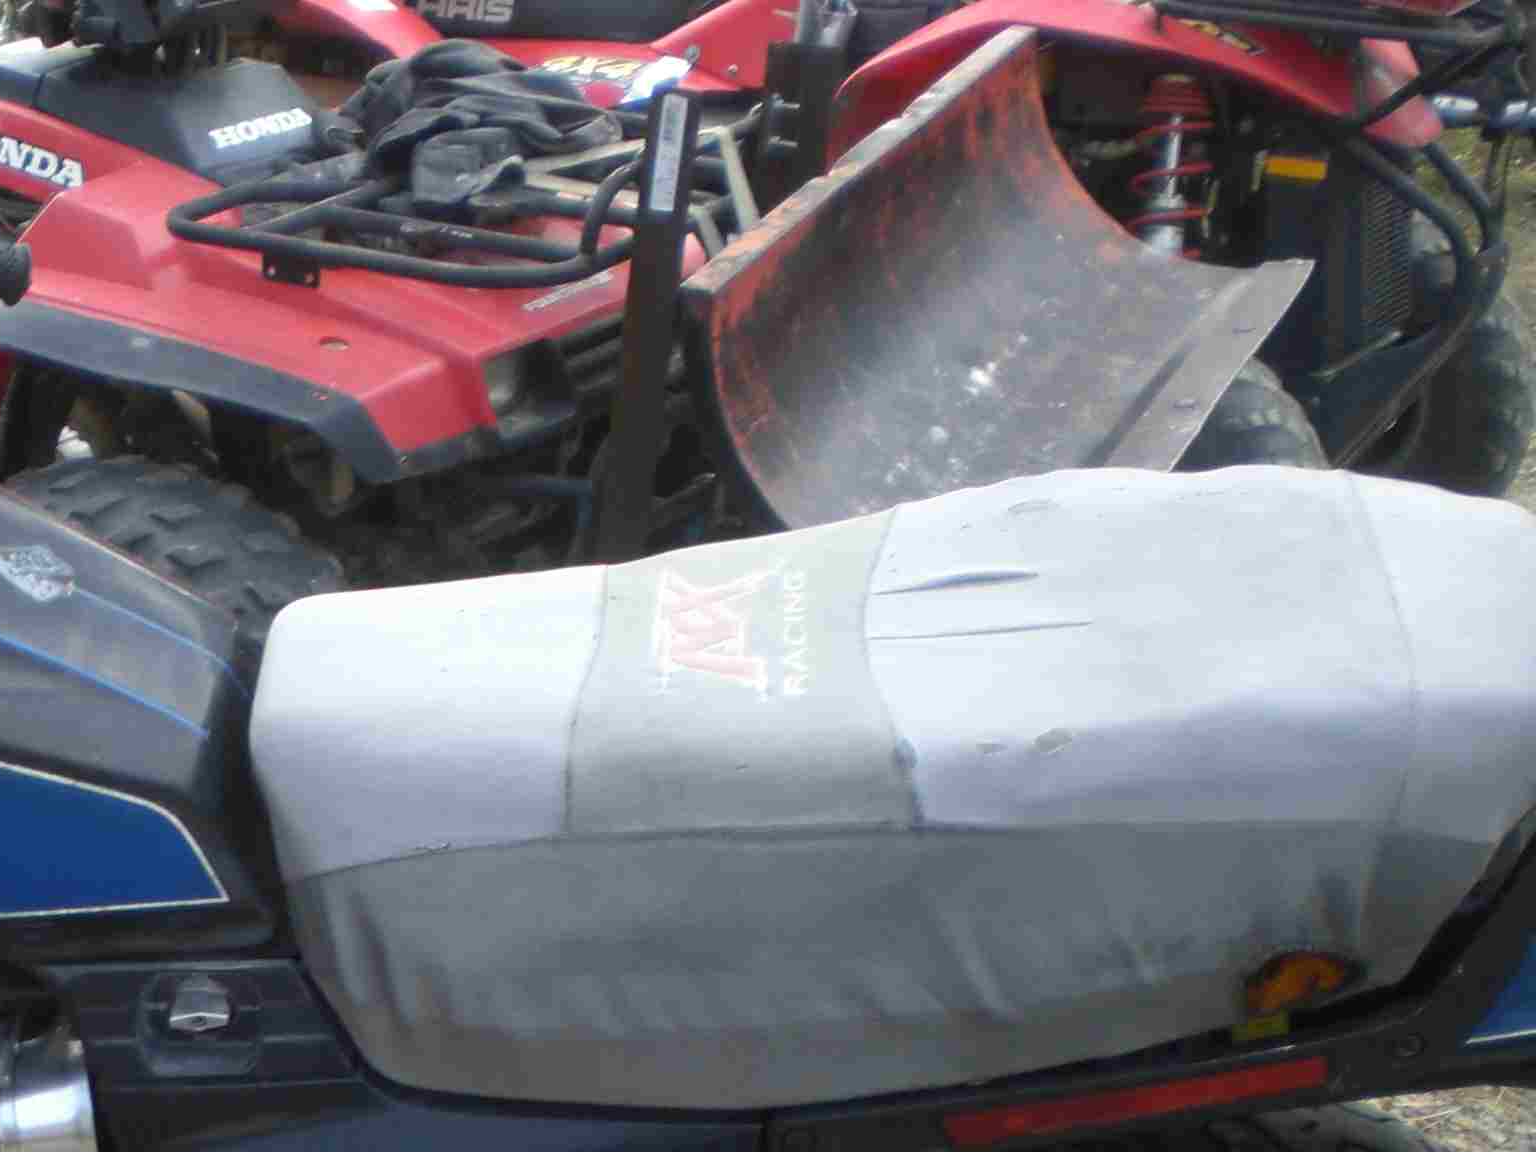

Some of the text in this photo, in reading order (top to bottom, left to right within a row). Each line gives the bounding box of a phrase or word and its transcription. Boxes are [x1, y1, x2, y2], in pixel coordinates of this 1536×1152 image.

[416, 0, 515, 23] ARIS
[208, 107, 312, 149] HONDA
[782, 567, 810, 696] RACING
